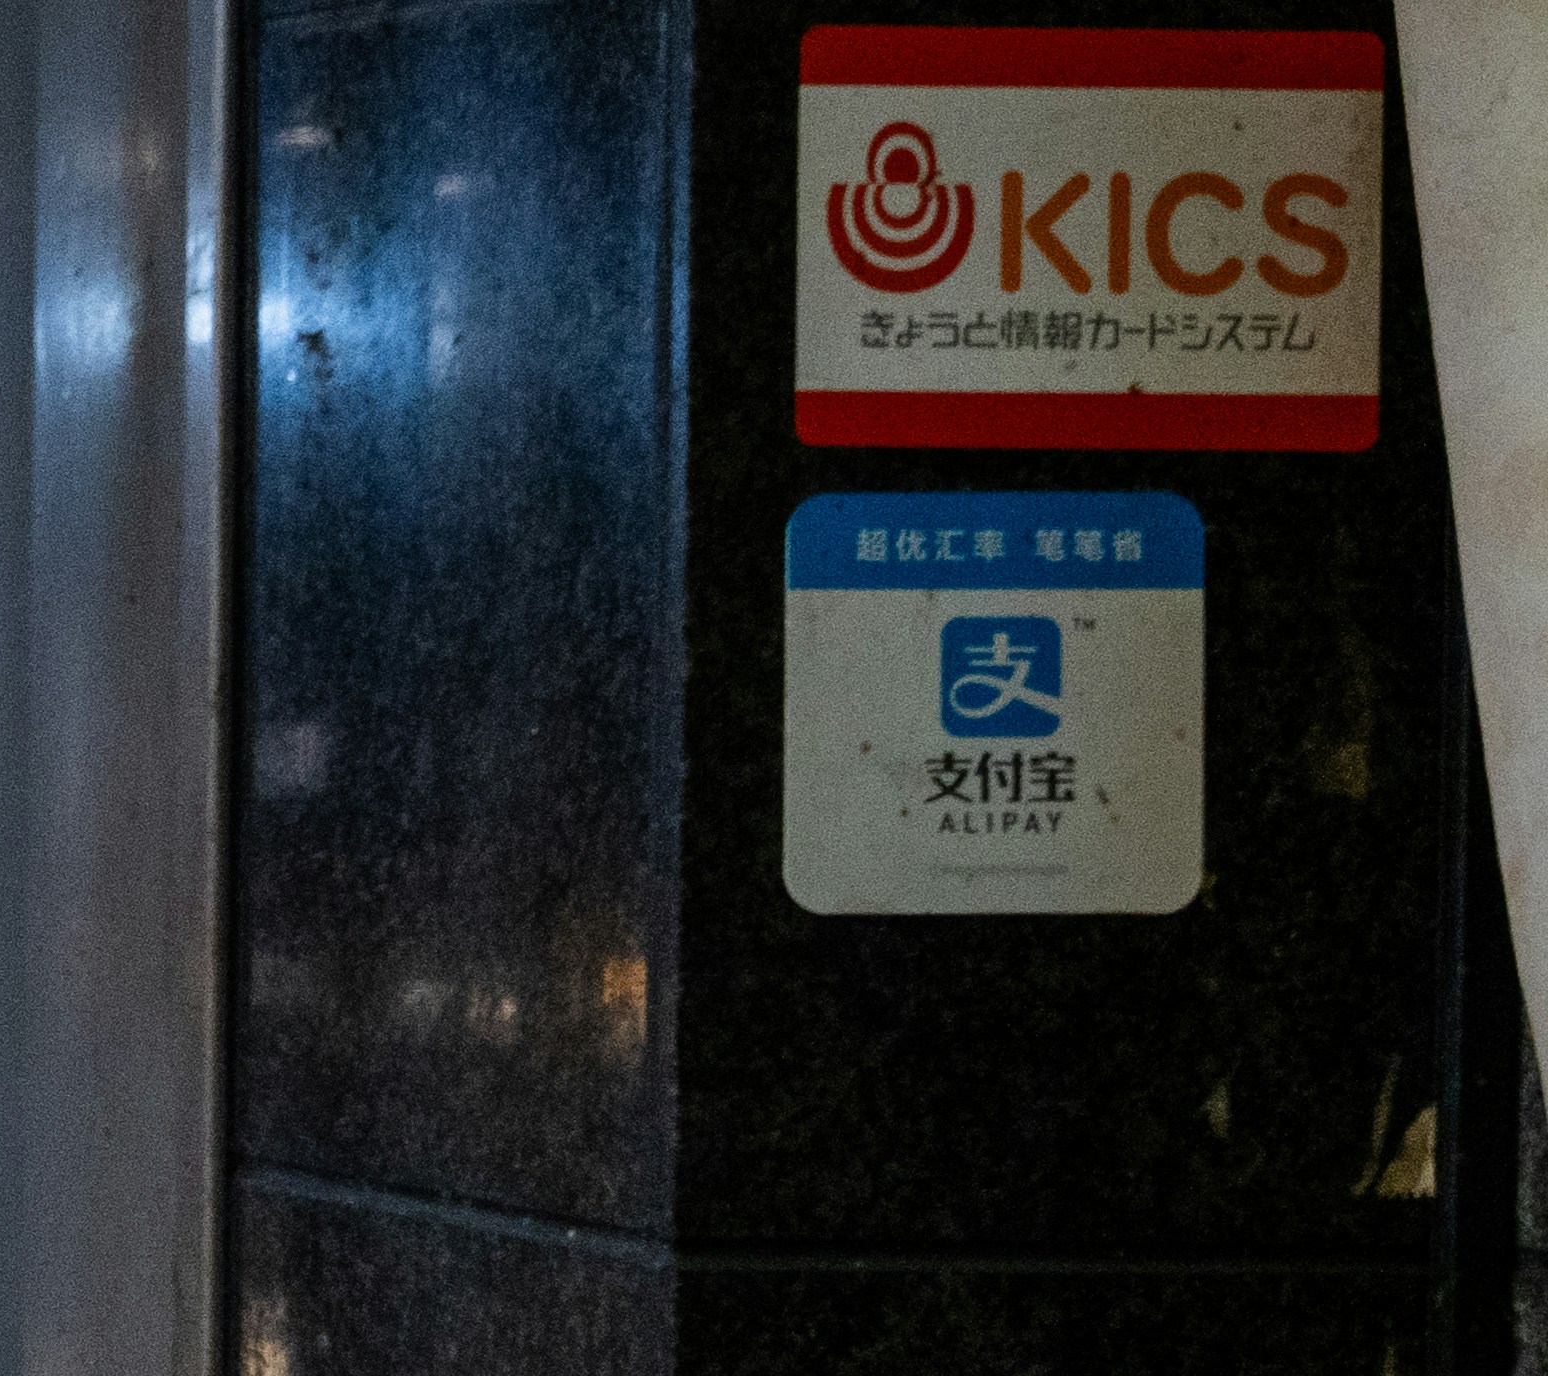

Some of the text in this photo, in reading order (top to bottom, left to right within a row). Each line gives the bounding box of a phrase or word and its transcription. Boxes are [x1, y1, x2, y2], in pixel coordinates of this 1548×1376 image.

[999, 170, 1350, 298] KICS
[859, 310, 1317, 353] きょうと情報カードシステム
[923, 751, 1078, 803] 支付宝
[938, 811, 1063, 835] ALIPAY
